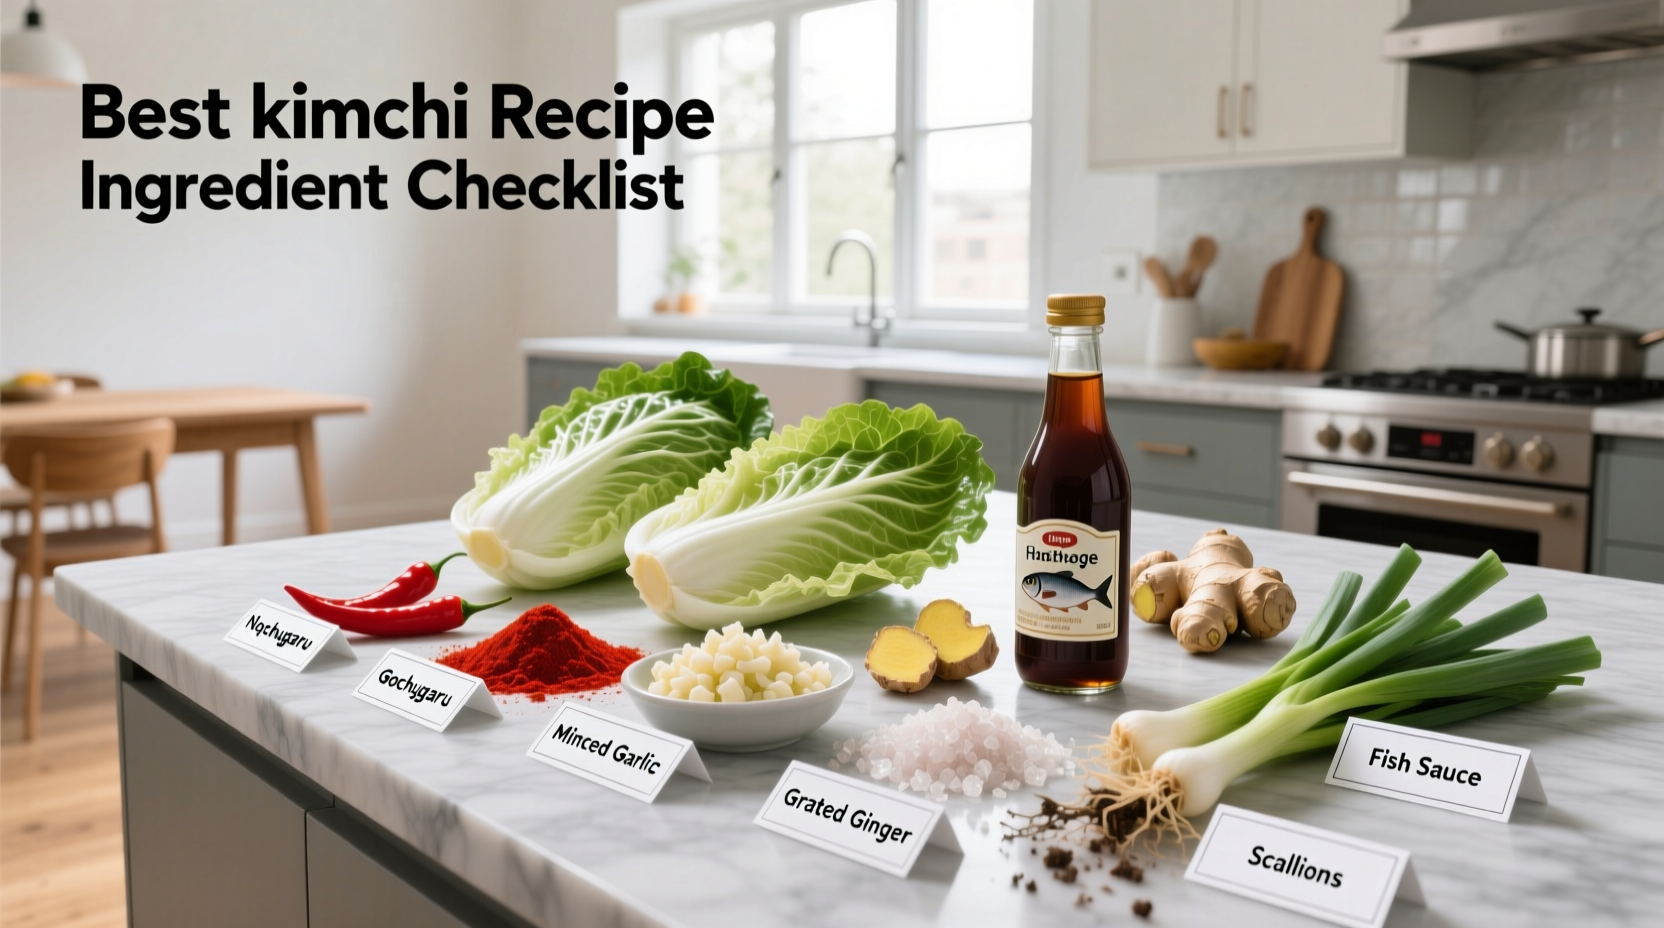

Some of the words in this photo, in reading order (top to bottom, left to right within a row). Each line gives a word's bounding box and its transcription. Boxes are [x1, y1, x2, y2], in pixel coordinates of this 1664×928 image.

[551, 723, 614, 757] Minced
[612, 744, 661, 775] Garlic
[1368, 747, 1411, 773] Fish
[1415, 756, 1482, 787] Sauce
[784, 788, 849, 824] Grated
[850, 809, 913, 844] Ginger
[1247, 845, 1344, 888] Scallions
